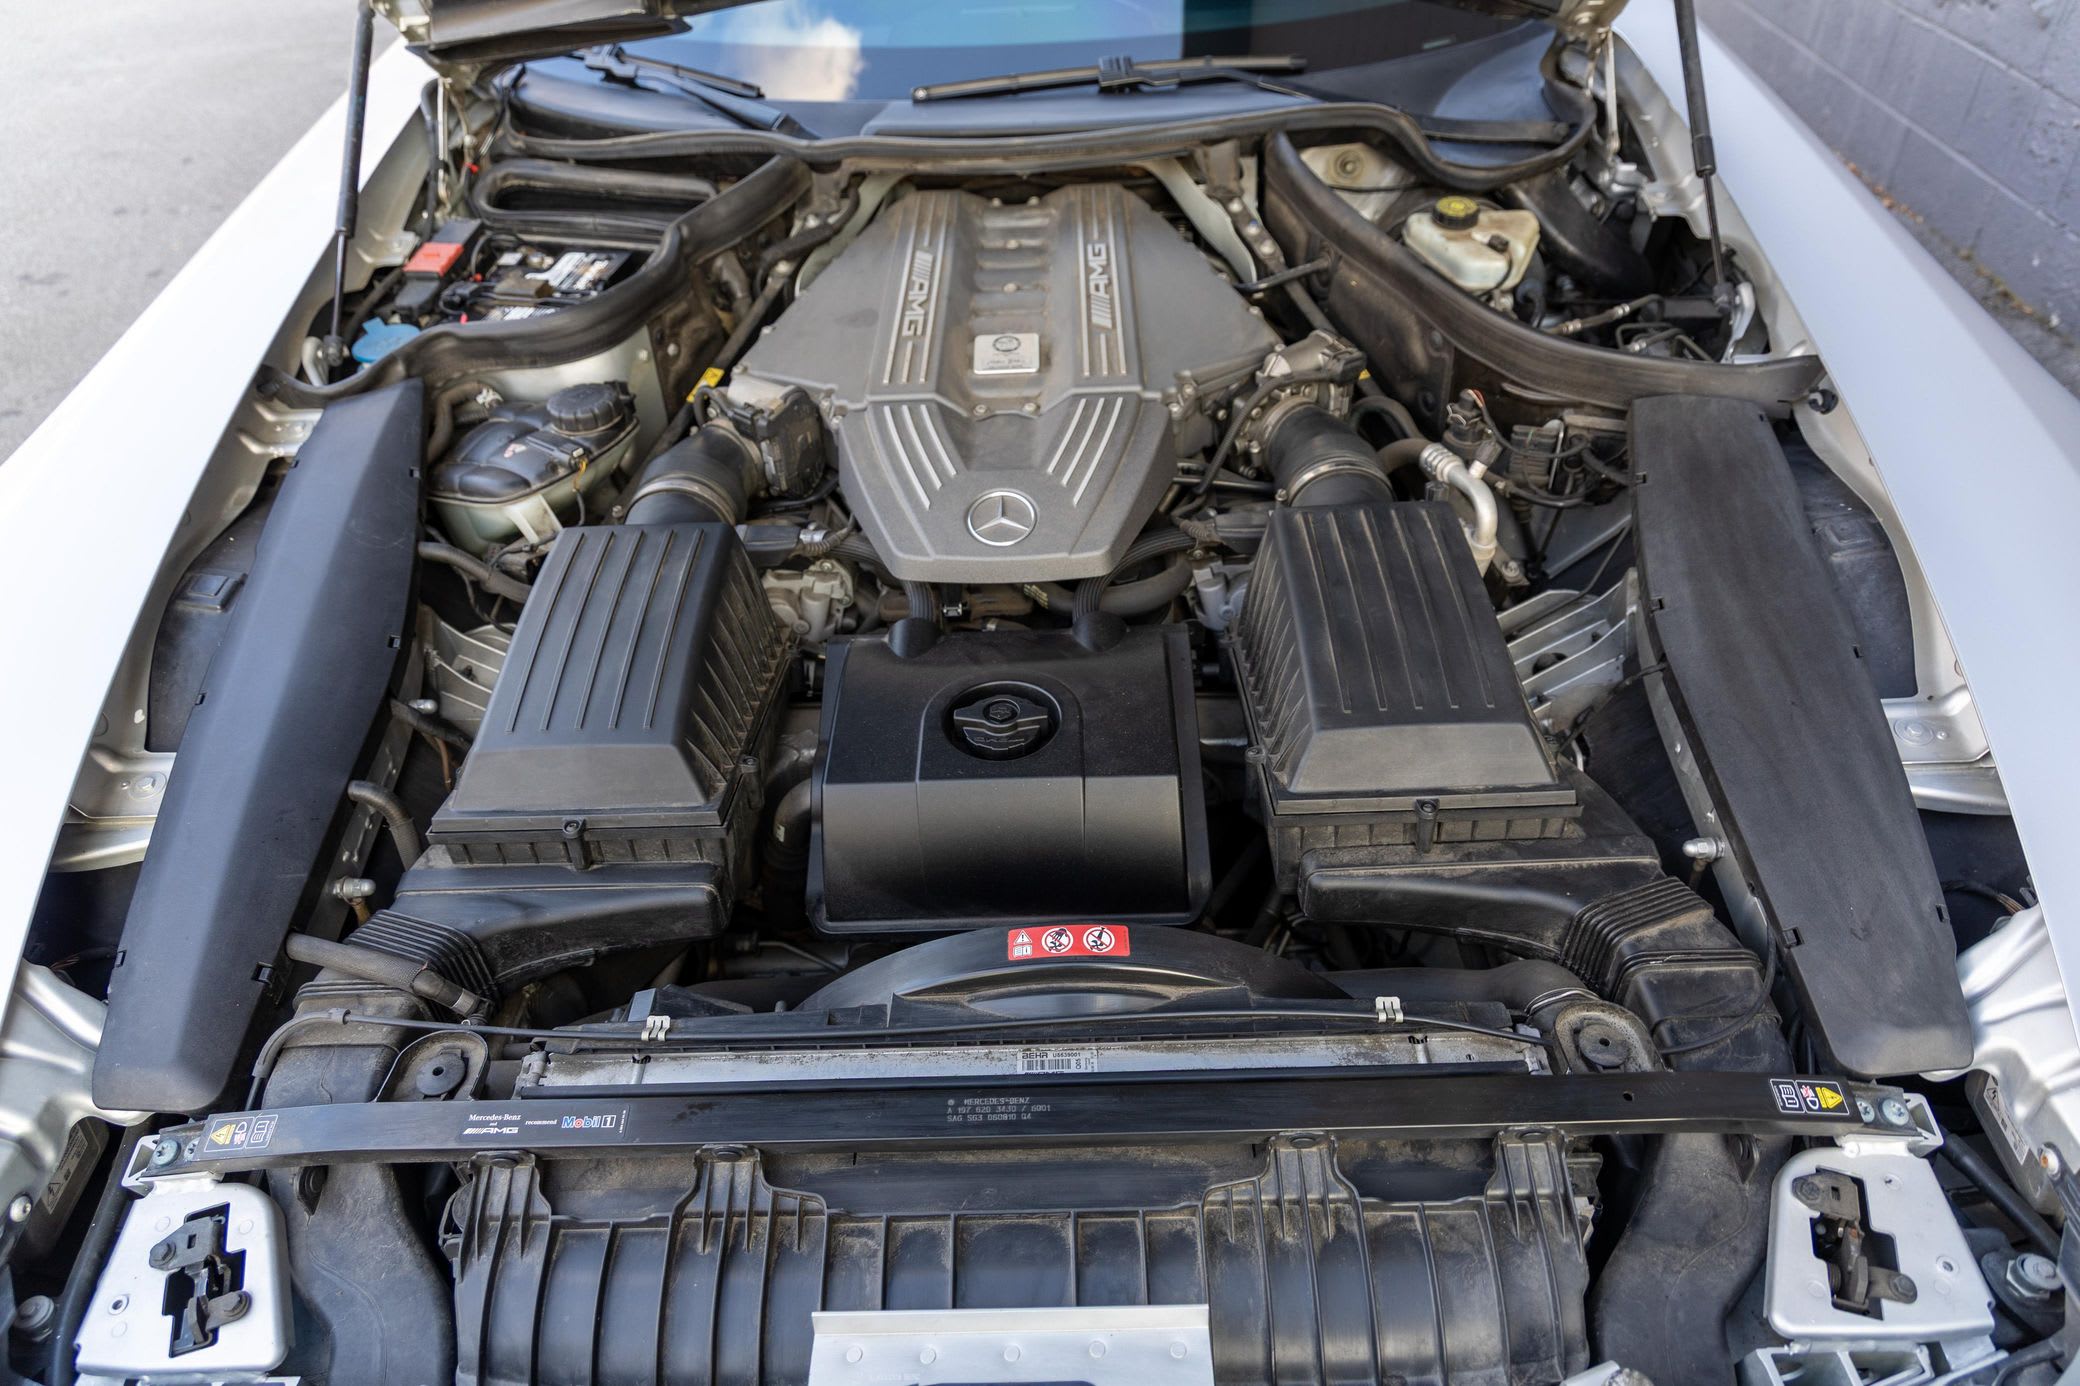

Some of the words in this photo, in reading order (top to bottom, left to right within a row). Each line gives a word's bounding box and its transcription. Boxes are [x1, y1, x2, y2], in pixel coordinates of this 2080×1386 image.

[1087, 242, 1111, 299] AMG
[902, 279, 931, 337] AMG
[964, 1097, 1030, 1106] MERCEDES-BENZ
[468, 1113, 521, 1122] Mercedes-Benz
[561, 1115, 601, 1129] Mobil
[481, 1127, 519, 1135] AMG
